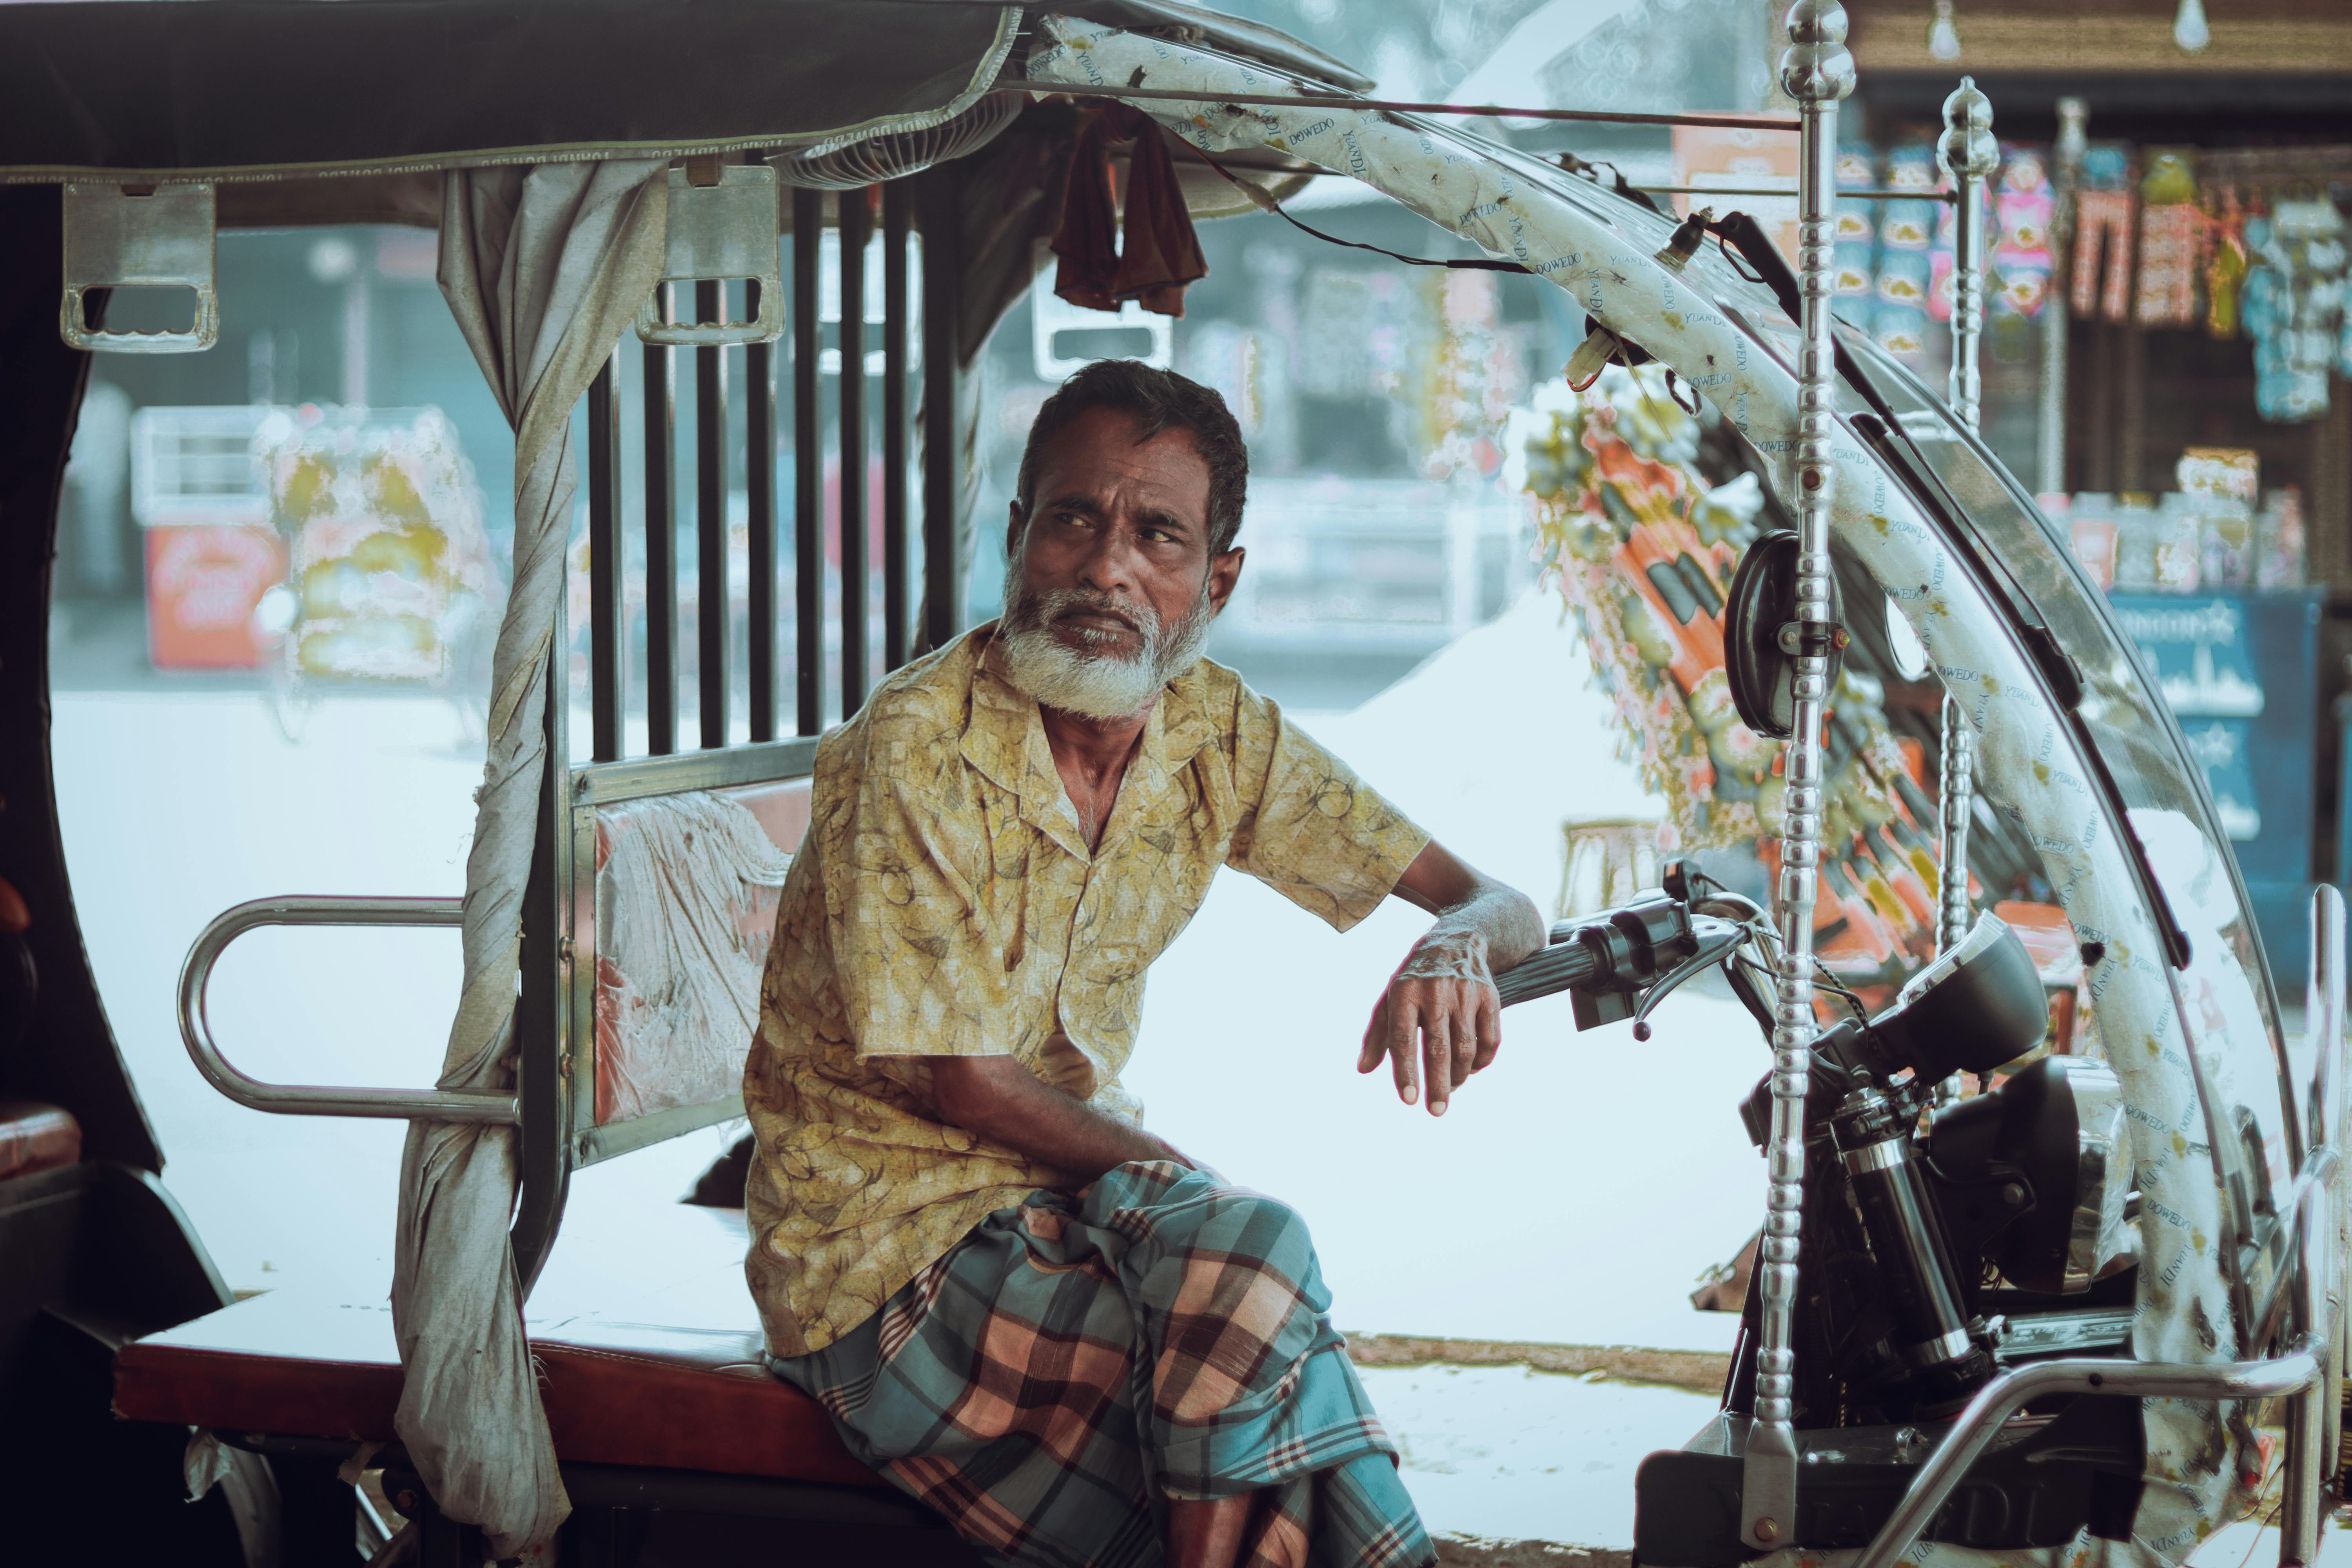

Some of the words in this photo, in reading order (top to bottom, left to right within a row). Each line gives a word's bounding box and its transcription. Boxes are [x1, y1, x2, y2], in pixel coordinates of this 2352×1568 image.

[1027, 44, 1067, 76] DOWEDO
[1151, 42, 1170, 59] EDO
[1077, 51, 1104, 86] YUAND
[1239, 67, 1257, 85] EDO
[1289, 118, 1334, 146] DOWEDO
[1360, 116, 1392, 125] YUAN
[1343, 129, 1367, 173] YUANDI
[1509, 216, 1528, 262] YUANDI
[1535, 252, 1582, 274] DOWEDO
[1588, 268, 1603, 313] YUANDI
[1931, 550, 1945, 591] OWEDO
[1885, 588, 1924, 601] OWEDO
[1939, 666, 1978, 682] OWEDO
[2034, 835, 2074, 854] OWEDO
[2059, 867, 2083, 905] YUAND
[2072, 922, 2111, 945] OWEDO
[2125, 1103, 2171, 1134] DOWEDO
[2141, 1147, 2174, 1191] YUANDI
[2146, 1199, 2192, 1231] DOWEDO
[2160, 1244, 2195, 1287] YUANDI
[2150, 1527, 2196, 1551] YUANDI
